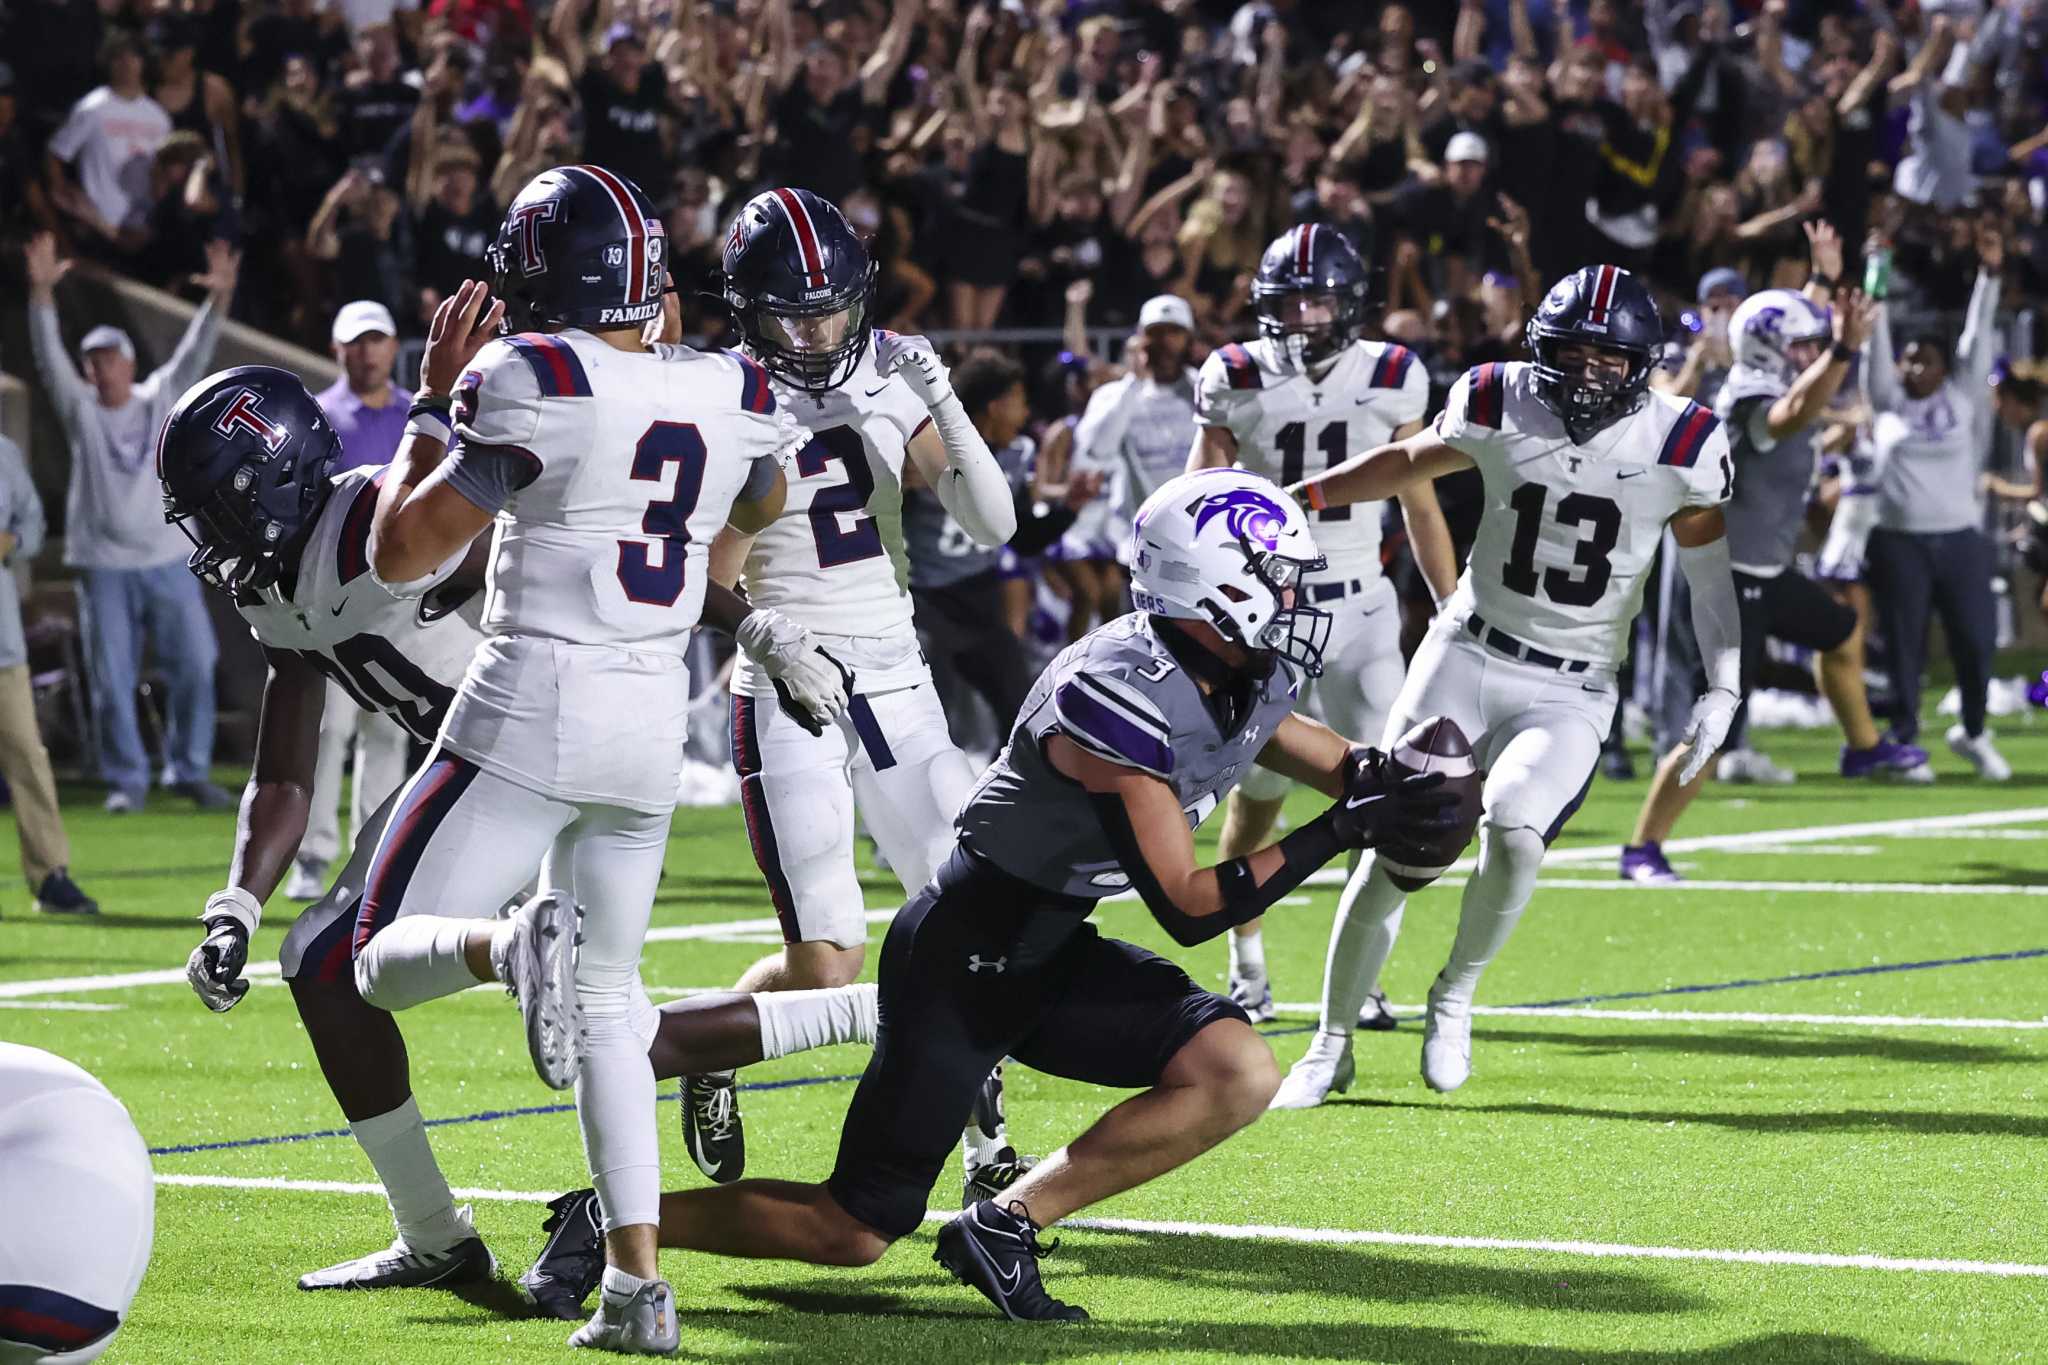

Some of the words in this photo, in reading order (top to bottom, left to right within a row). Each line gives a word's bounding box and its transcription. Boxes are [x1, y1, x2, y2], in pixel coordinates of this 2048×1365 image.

[508, 199, 560, 278] T
[599, 302, 660, 324] FAMILY
[648, 263, 662, 297] 3
[804, 287, 833, 301] FALCONS
[211, 387, 293, 459] T
[796, 424, 885, 569] 2
[1275, 420, 1351, 522] 11
[1568, 456, 1582, 474] T
[616, 420, 708, 608] 3
[1502, 481, 1623, 607] 13
[1136, 657, 1177, 684] 3
